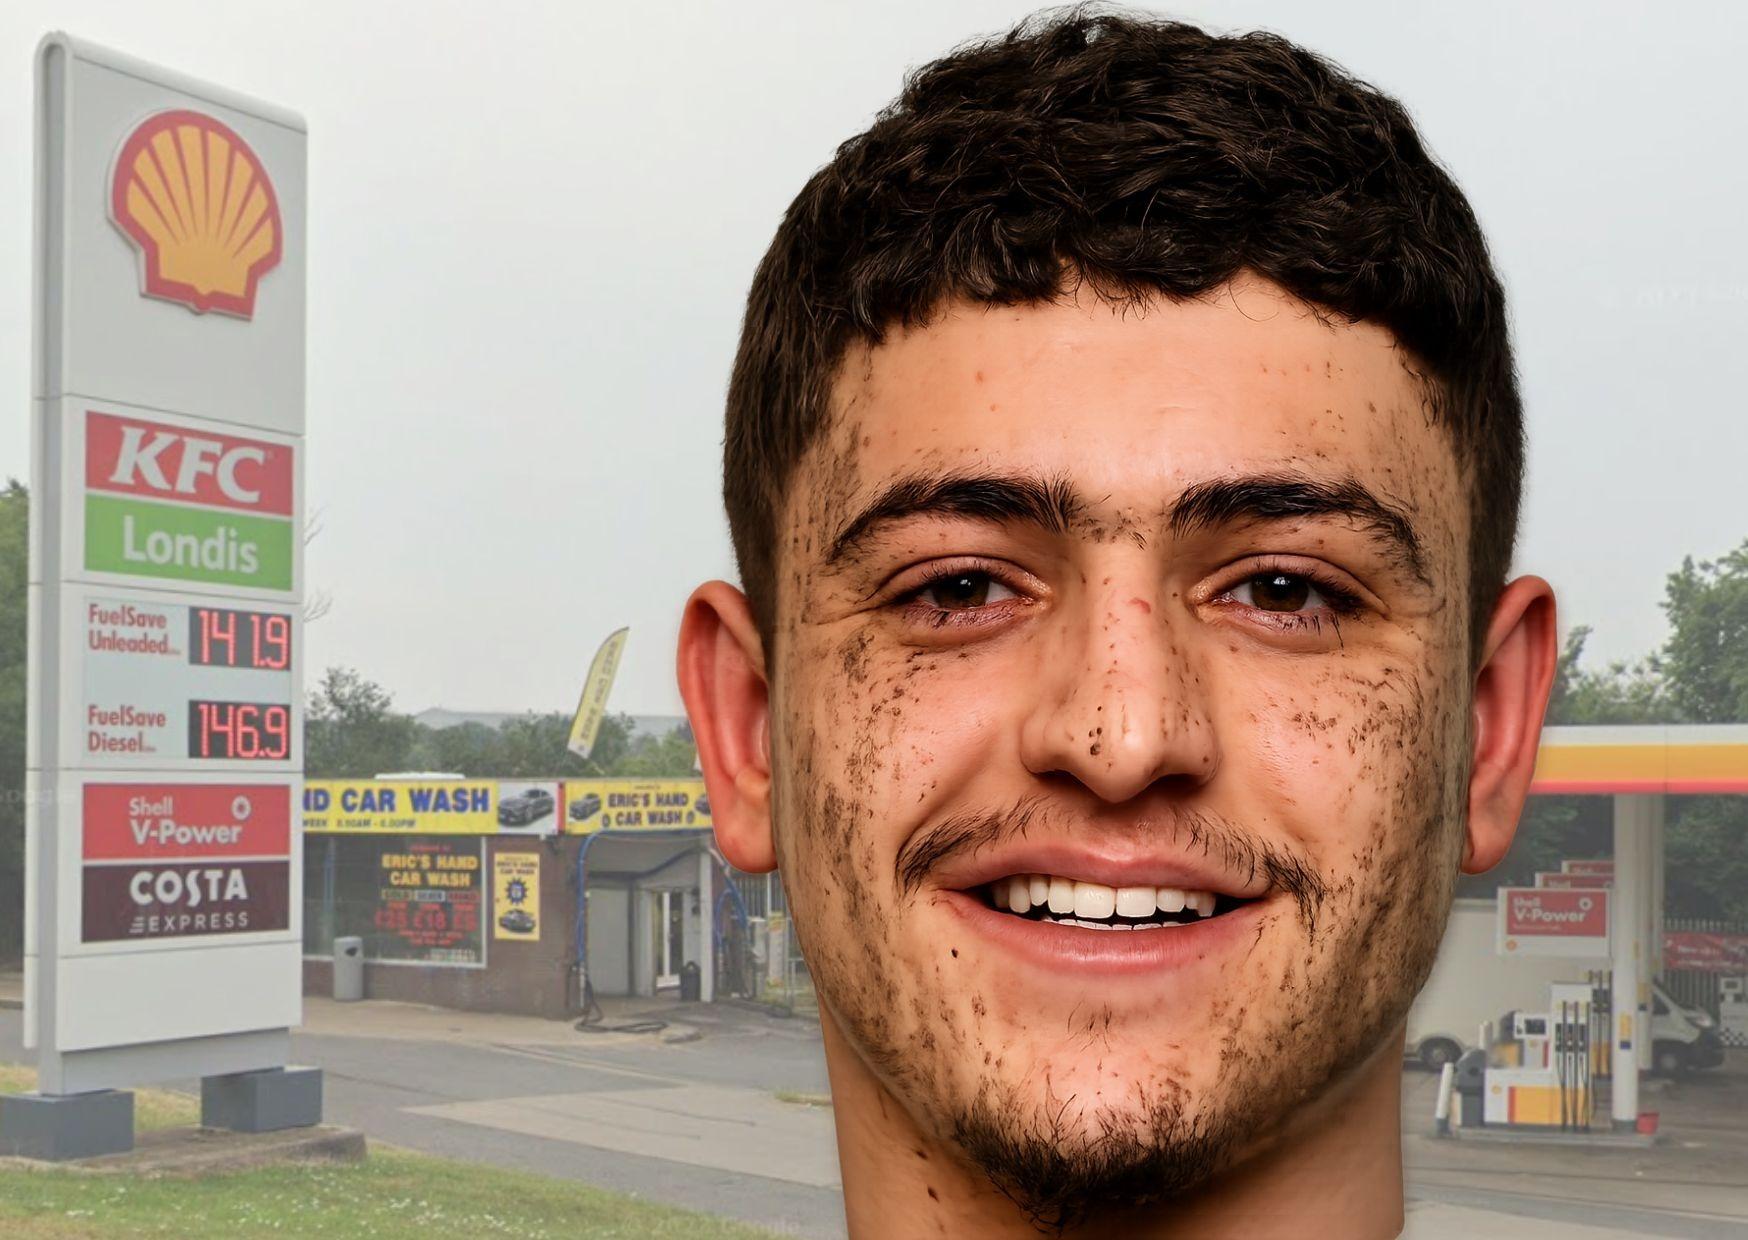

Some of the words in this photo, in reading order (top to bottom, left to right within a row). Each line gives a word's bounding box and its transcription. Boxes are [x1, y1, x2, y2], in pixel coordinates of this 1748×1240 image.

[109, 425, 266, 503] KFC
[123, 515, 259, 574] Londis
[89, 603, 167, 629] FuelSave
[88, 704, 166, 728] FuelSave
[88, 731, 143, 752] Diesel
[198, 704, 288, 759] 146.9
[129, 795, 173, 816] Shell
[341, 787, 396, 813] CAR
[408, 787, 490, 813] WASH
[608, 792, 650, 808] ERIC'S
[655, 792, 689, 807] HAND
[615, 811, 642, 826] CAR
[647, 810, 682, 825] WASH
[130, 818, 242, 845] V-Power
[382, 854, 431, 870] ERIC'S
[437, 855, 479, 871] HAND
[130, 868, 248, 907] COSTA
[390, 871, 421, 886] CAR
[426, 872, 471, 888] WASH
[148, 911, 248, 933] EXPRESS
[1514, 907, 1587, 923] V-Power
